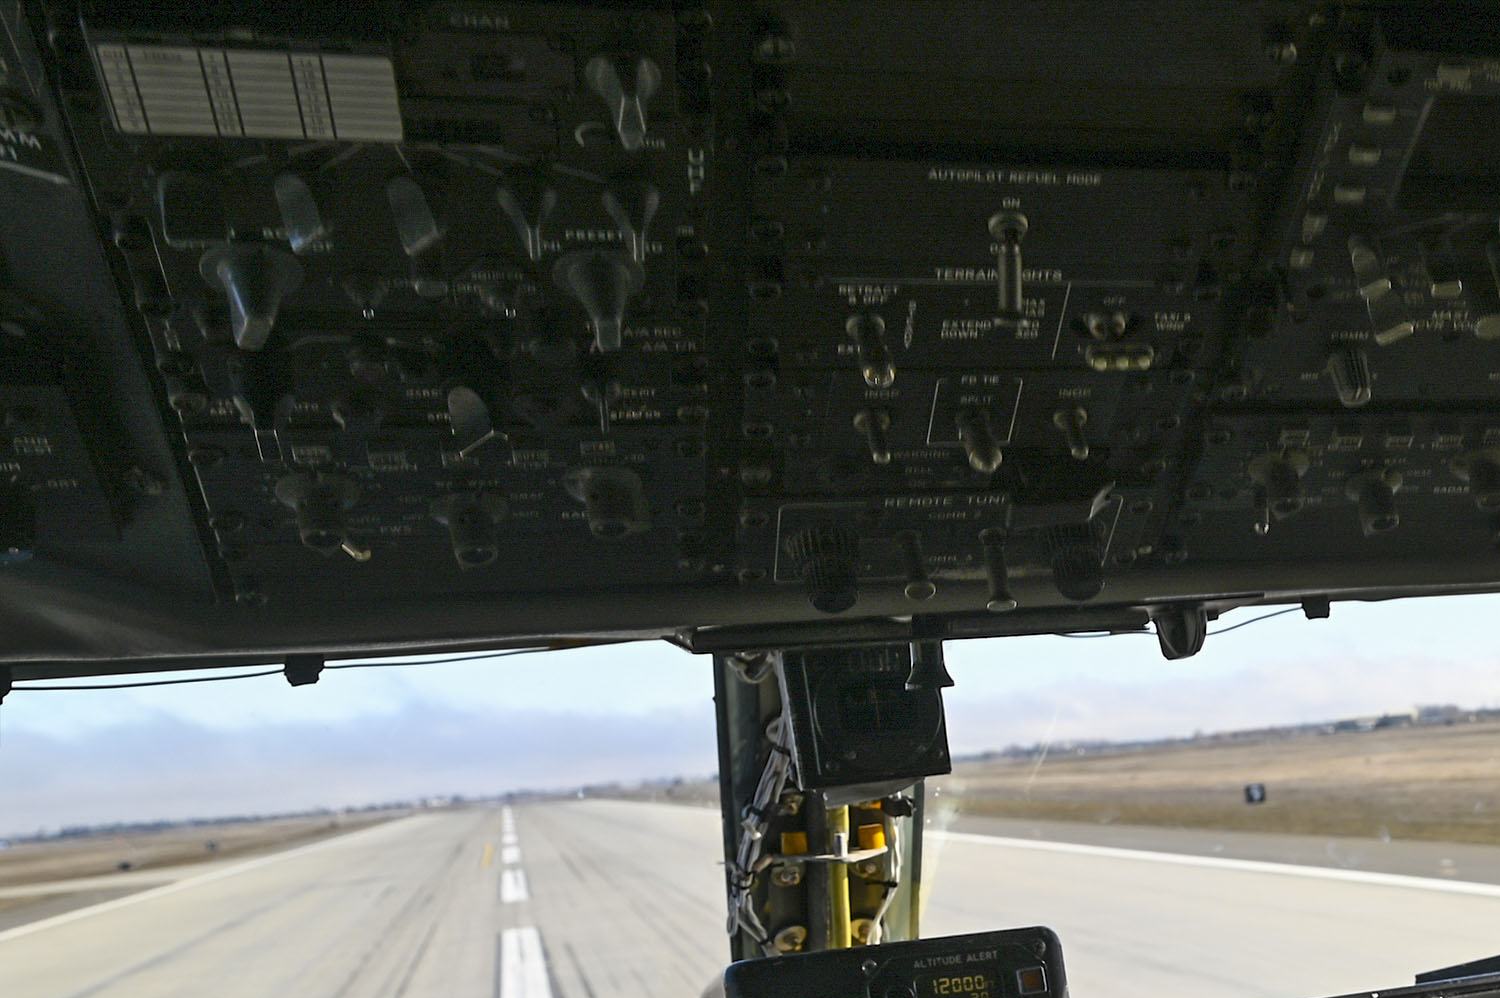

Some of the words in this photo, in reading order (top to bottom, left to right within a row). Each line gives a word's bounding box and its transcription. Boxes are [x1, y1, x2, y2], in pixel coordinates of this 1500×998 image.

[928, 167, 1006, 183] AUTOPILOT
[1009, 170, 1060, 185] REFUEL
[884, 494, 954, 508] REMOTE
[913, 954, 962, 969] ALTITUDE
[966, 950, 998, 963] ALERT
[933, 974, 985, 996] 12000
